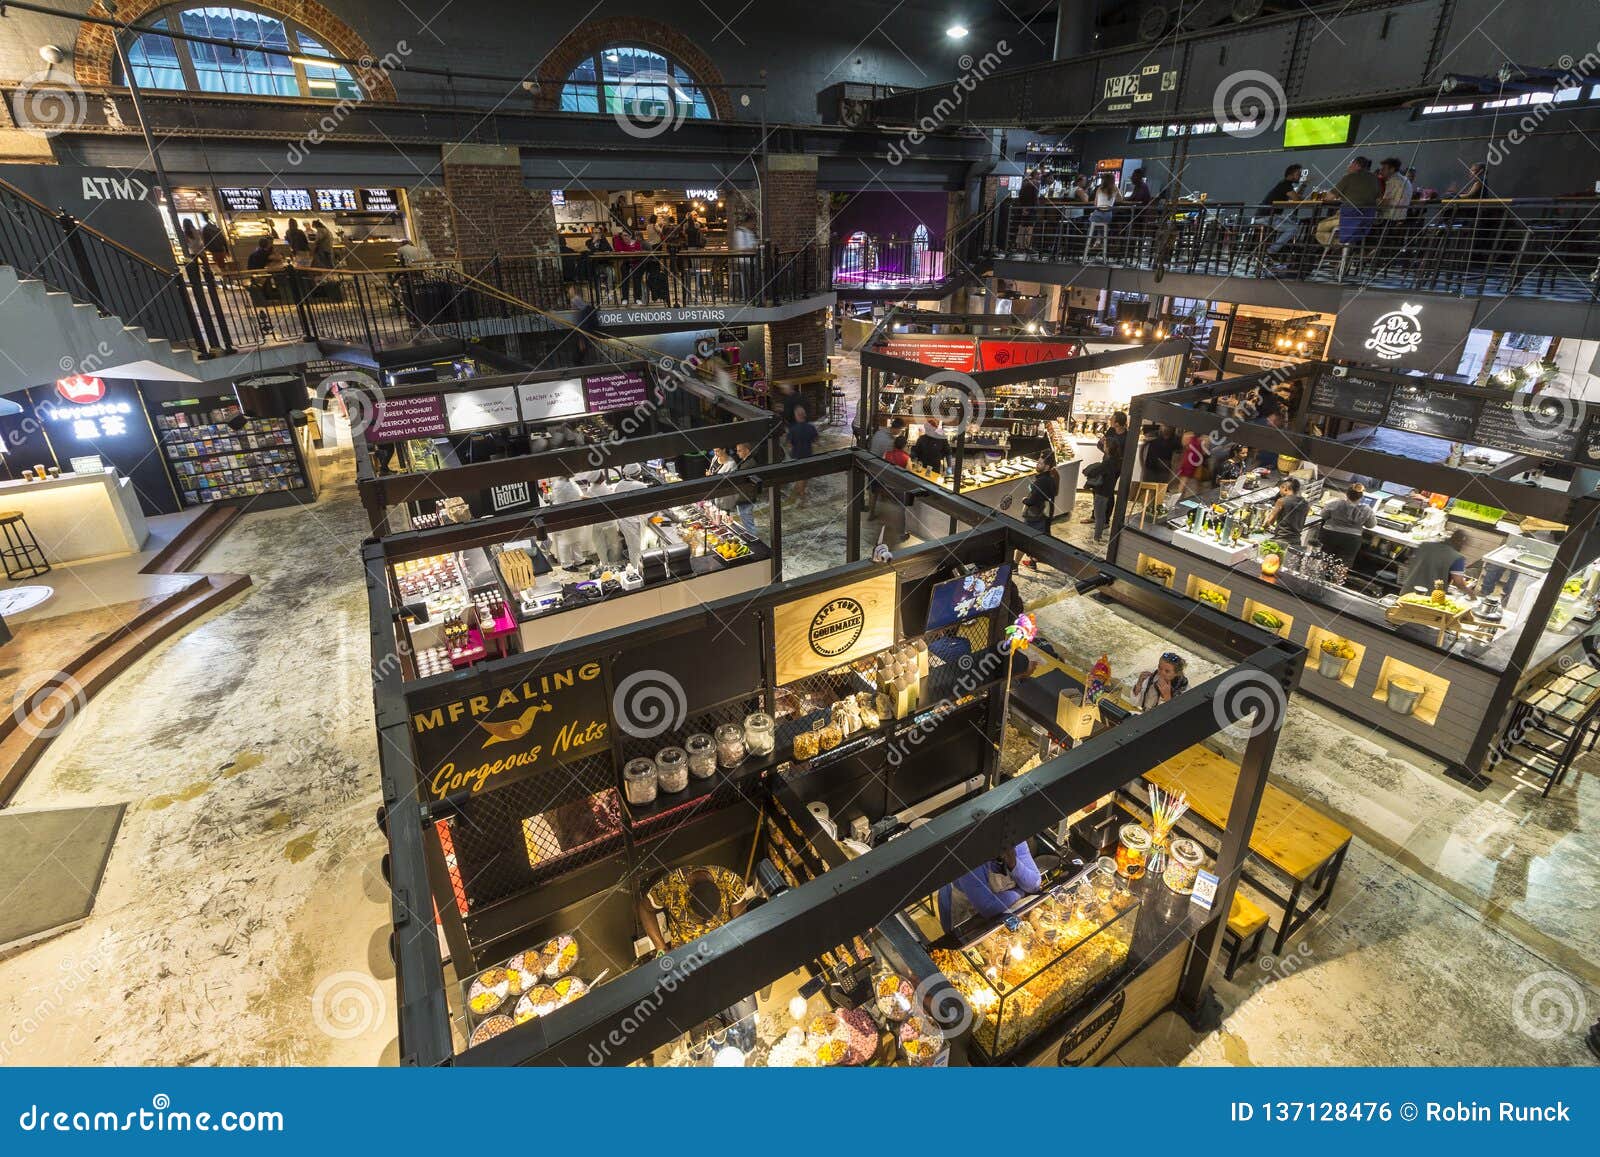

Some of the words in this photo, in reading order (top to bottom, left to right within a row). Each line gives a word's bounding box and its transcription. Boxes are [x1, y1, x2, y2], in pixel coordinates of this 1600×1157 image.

[82, 177, 134, 200] ATM
[222, 189, 240, 197] THE
[227, 197, 245, 205] HUT
[628, 311, 672, 323] VENDORS
[678, 310, 725, 321] UPSTAIRS
[1365, 324, 1423, 350] Juice
[497, 487, 527, 507] ROLLA
[816, 604, 835, 626] CAPE
[837, 600, 859, 614] TOWN
[813, 616, 861, 639] GOURMAIZE
[414, 663, 601, 733] MFRALING
[431, 745, 542, 801] Gorgeous
[552, 719, 607, 756] Nuts
